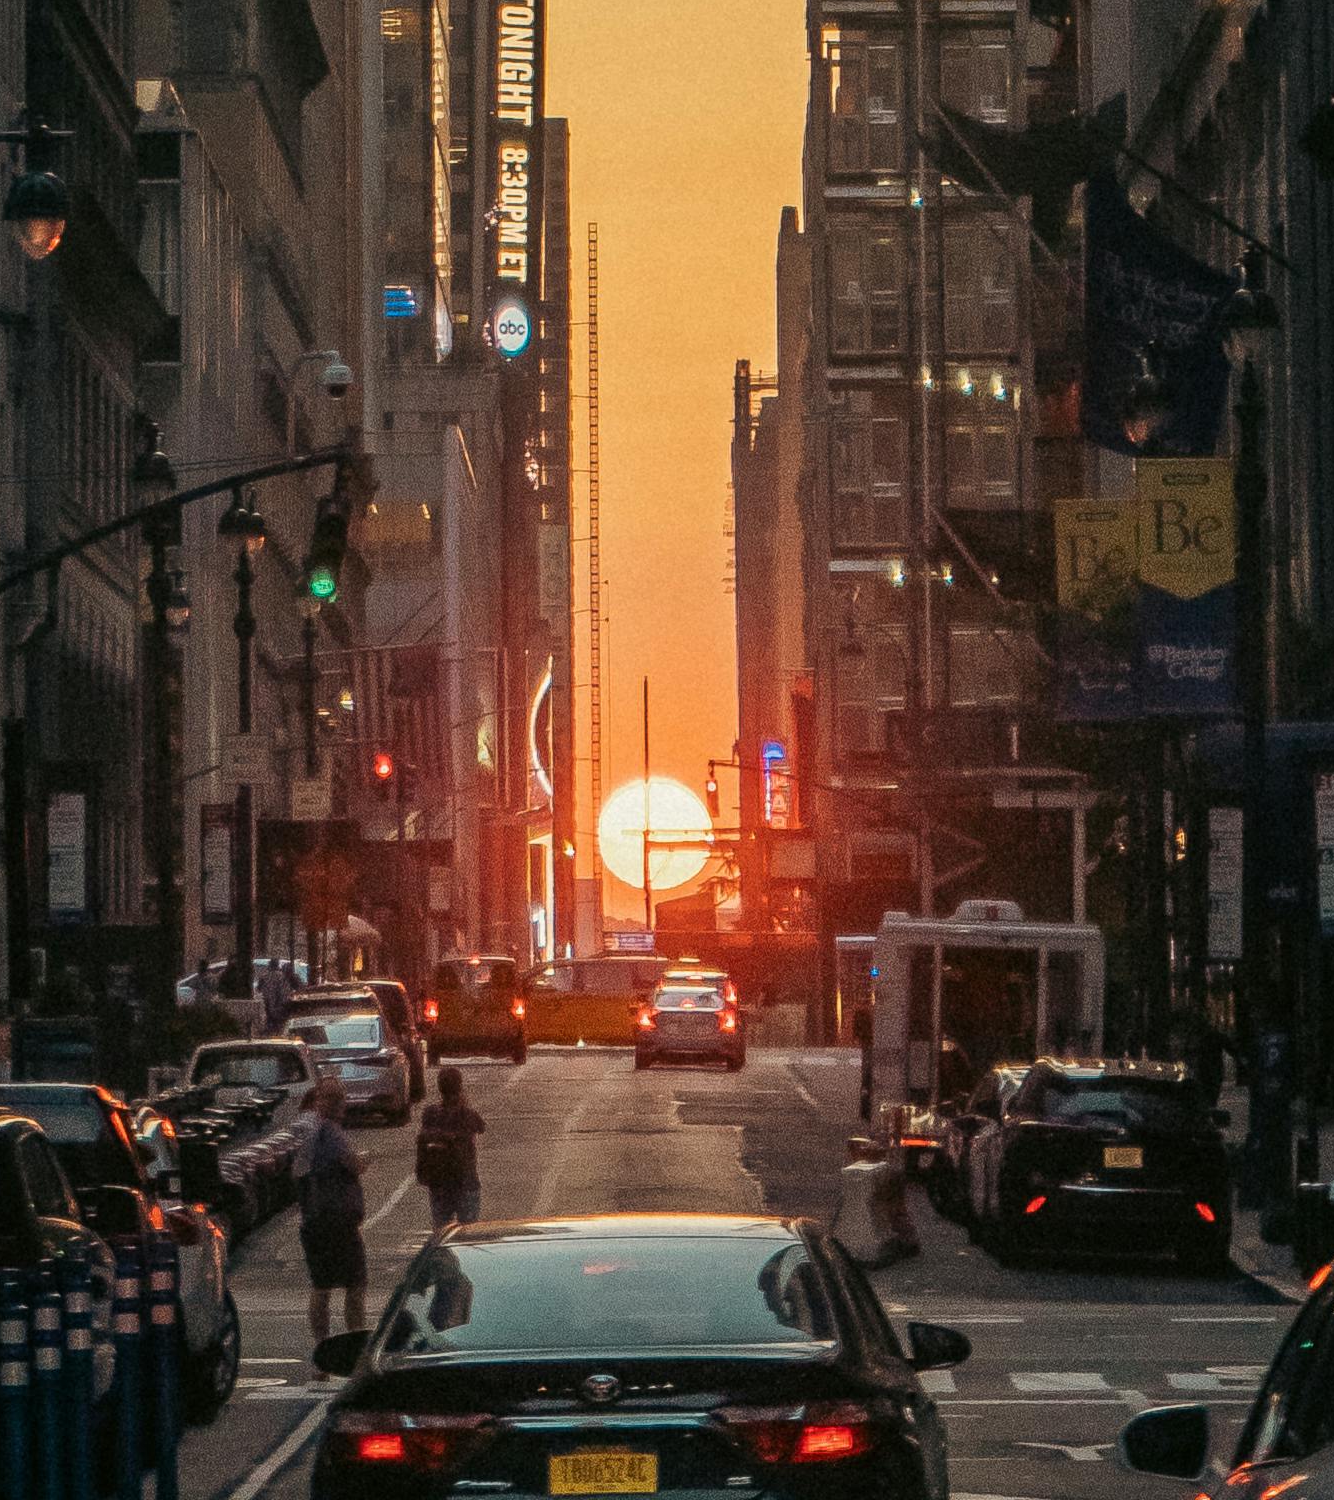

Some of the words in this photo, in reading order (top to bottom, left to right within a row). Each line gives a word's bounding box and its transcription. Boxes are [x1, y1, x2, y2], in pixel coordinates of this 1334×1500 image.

[497, 146, 529, 244] 8:30PM
[496, 252, 528, 283] ET
[498, 319, 526, 336] abc
[1152, 499, 1223, 556] Be
